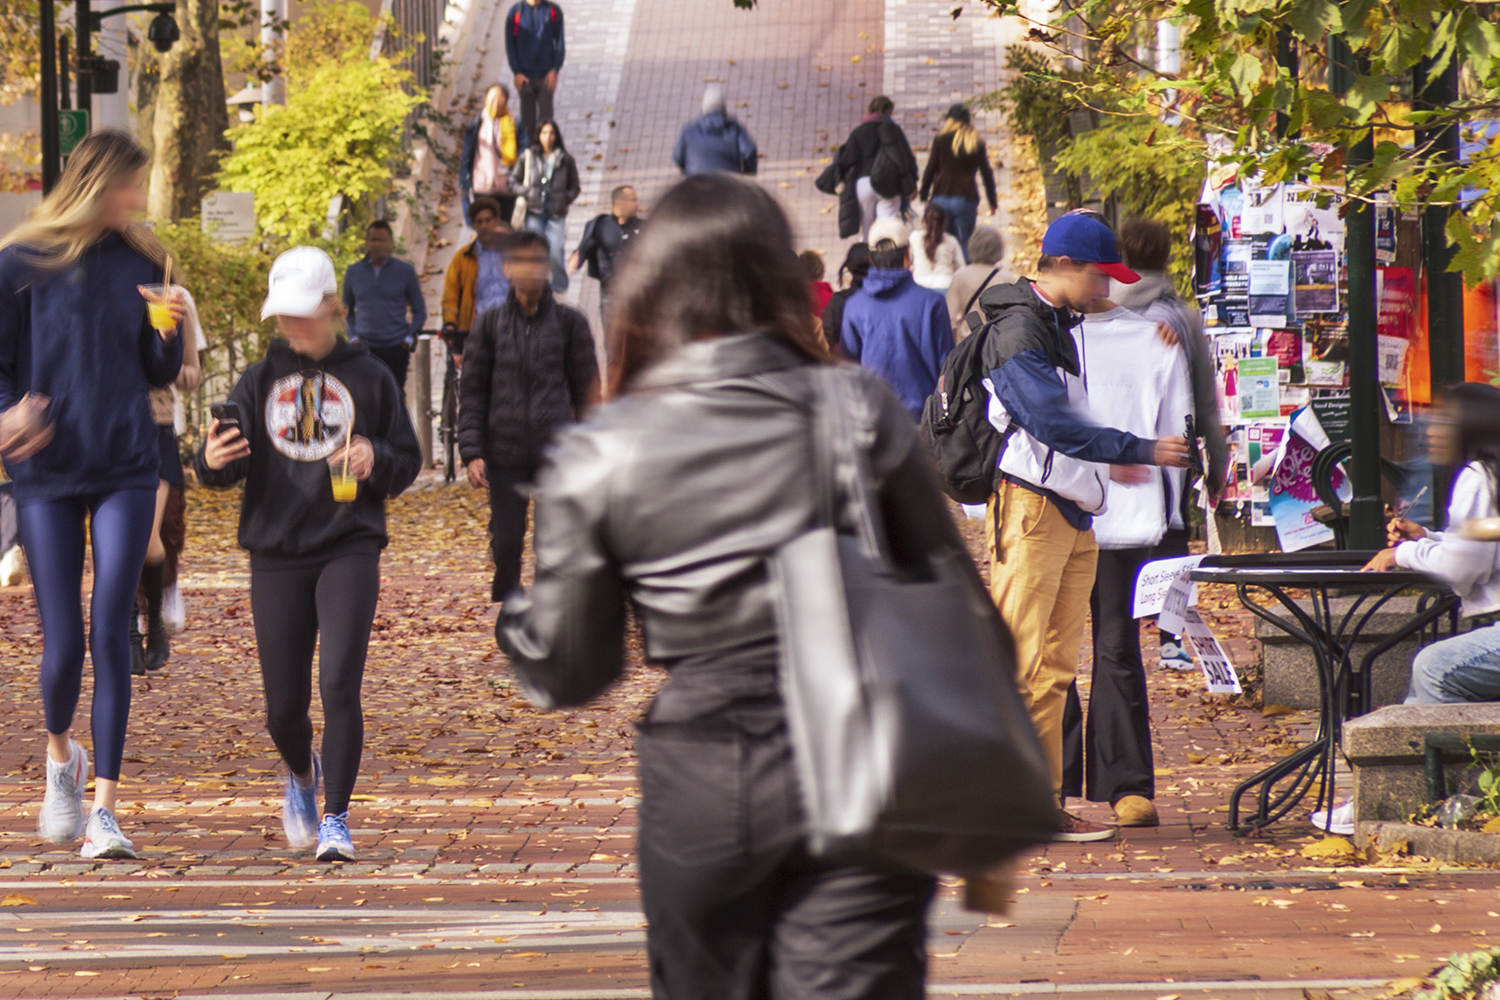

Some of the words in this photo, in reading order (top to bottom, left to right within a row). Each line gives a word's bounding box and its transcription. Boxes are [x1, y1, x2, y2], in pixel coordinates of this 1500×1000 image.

[1141, 574, 1159, 587] Short
[1140, 591, 1156, 605] Long
[1203, 660, 1235, 685] SALE
